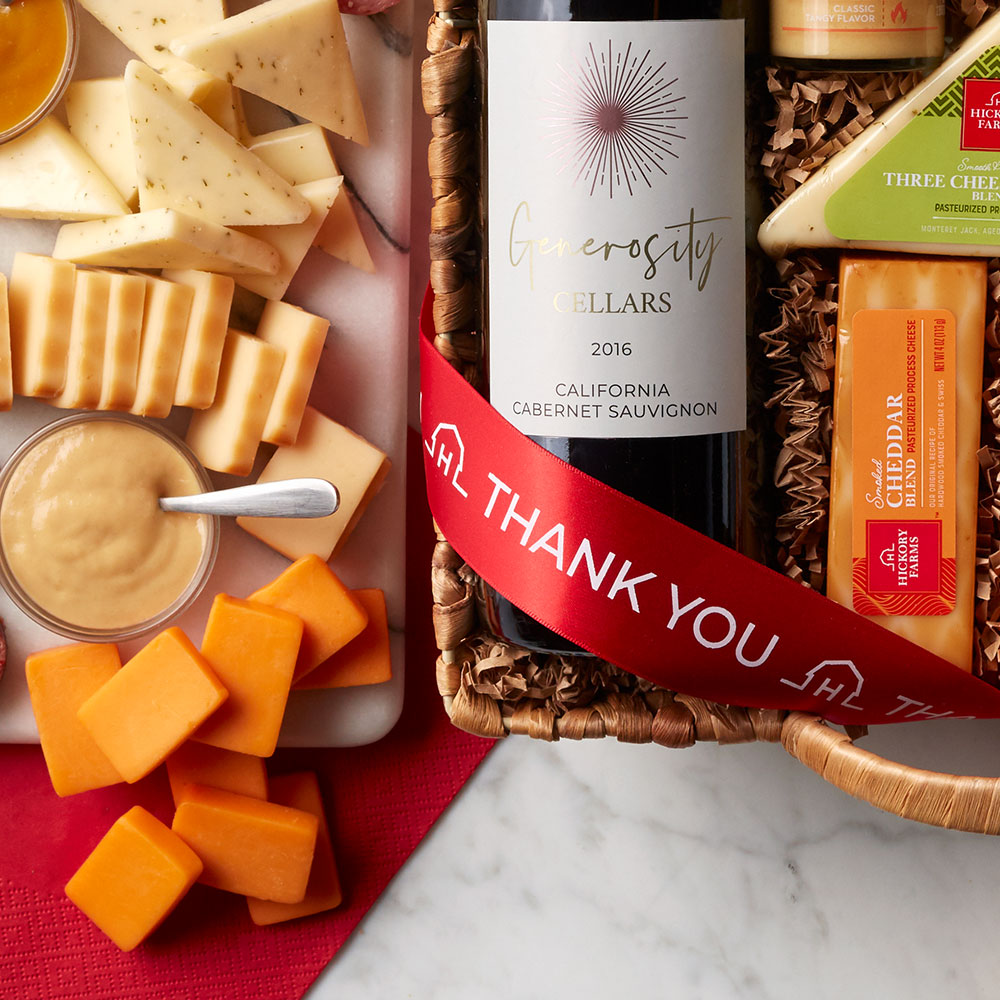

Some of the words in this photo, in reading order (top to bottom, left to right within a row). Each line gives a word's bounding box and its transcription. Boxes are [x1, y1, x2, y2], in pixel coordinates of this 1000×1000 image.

[833, 4, 875, 13] CLASSIC
[837, 14, 875, 23] FLAVOR
[883, 172, 945, 188] THREE
[934, 204, 987, 214] PASTEURIZED
[509, 201, 732, 292] Generosity
[553, 292, 672, 314] CELLARS
[907, 320, 916, 353] CHEESE
[934, 325, 946, 338] (113
[591, 342, 632, 356] 2016
[934, 338, 944, 346] OZ
[934, 351, 944, 360] WT
[907, 354, 916, 394] PROCESS
[934, 361, 944, 372] NET
[555, 383, 670, 397] CALIFORNIA
[513, 401, 602, 418] CABERNET
[608, 402, 718, 419] SAUVIGNON
[907, 395, 916, 453] PASTEURIZED
[886, 393, 903, 508] CHEDDAR
[866, 458, 885, 509] Smoked
[906, 459, 916, 507] BLEND
[898, 529, 908, 586] HICKORY
[909, 536, 919, 578] FARMS
[483, 472, 657, 614] THANK
[667, 583, 779, 667] YOU
